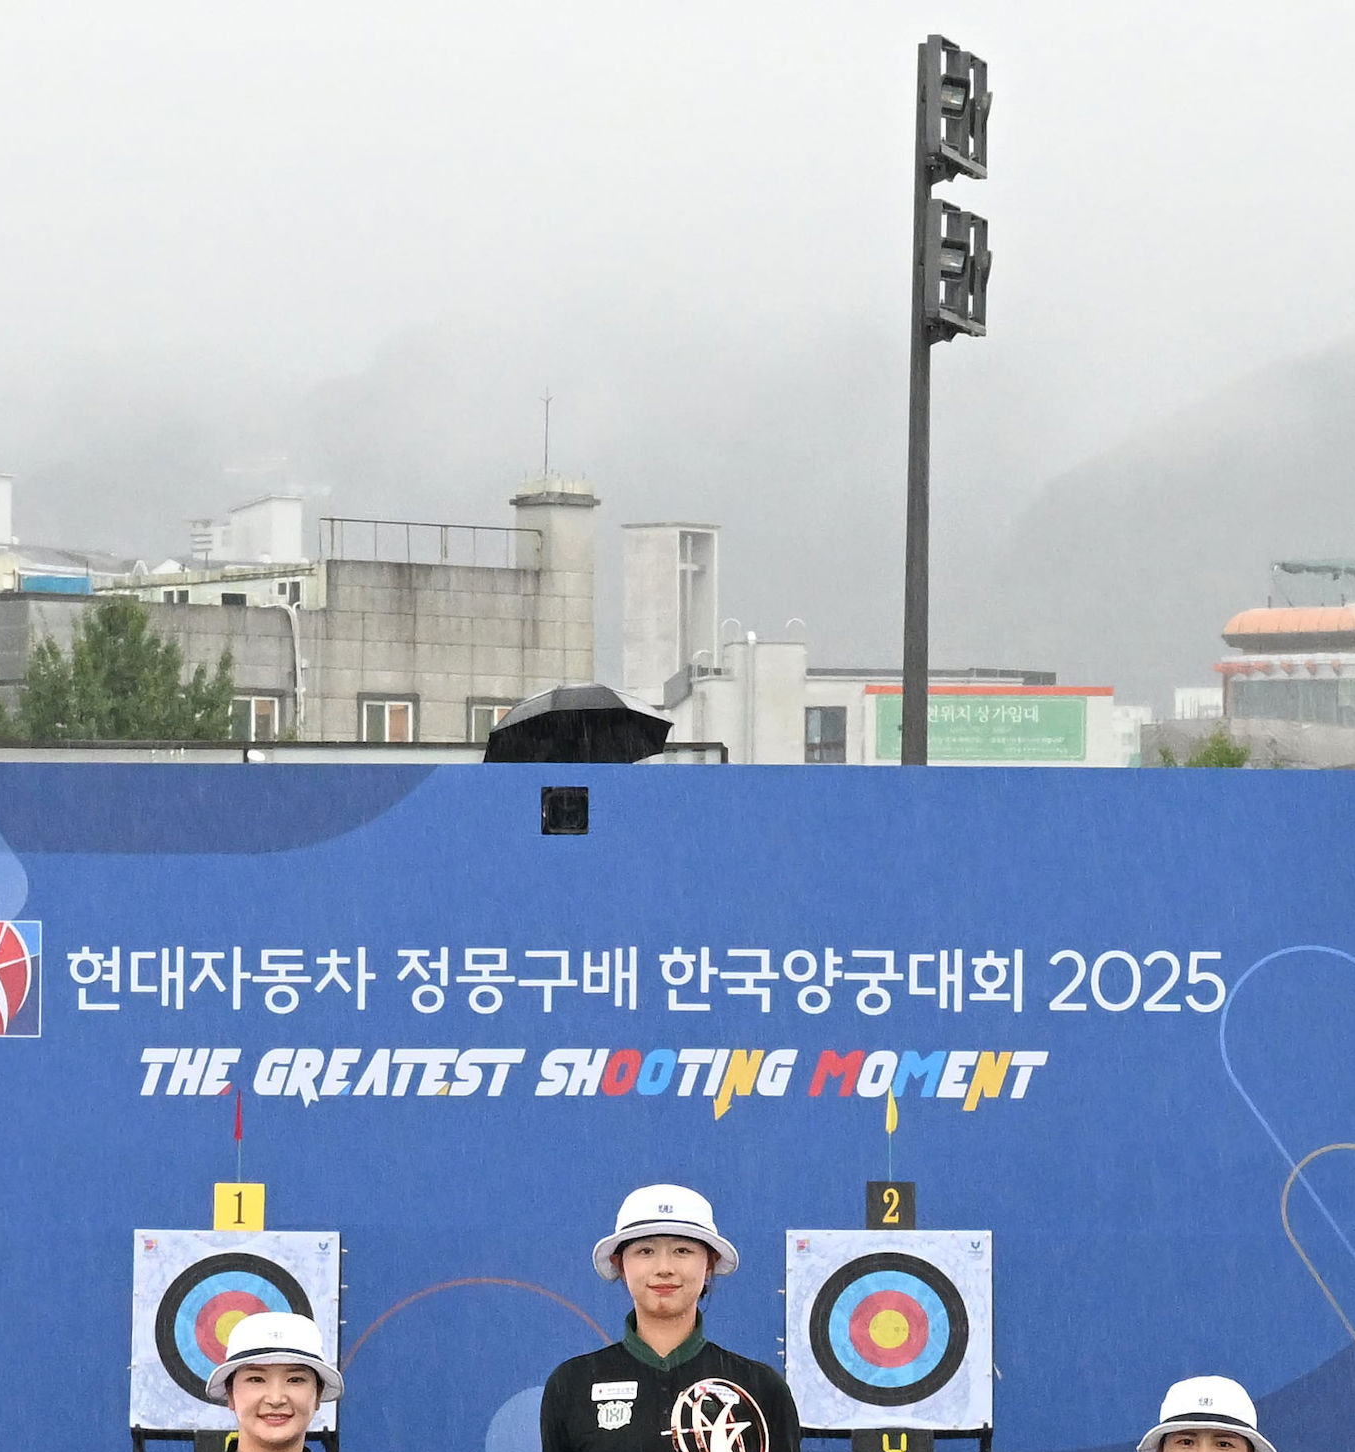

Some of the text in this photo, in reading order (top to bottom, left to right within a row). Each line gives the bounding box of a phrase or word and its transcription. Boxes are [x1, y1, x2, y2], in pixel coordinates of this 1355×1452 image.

[976, 704, 1040, 723] 상가임대
[67, 946, 1226, 1015] 현대자동차 정몽구배 한국양궁대회 2025
[141, 1048, 1048, 1120] THE GREATEST SHOOTING MOMENT
[233, 1191, 246, 1224] 1
[882, 1187, 900, 1224] 2
